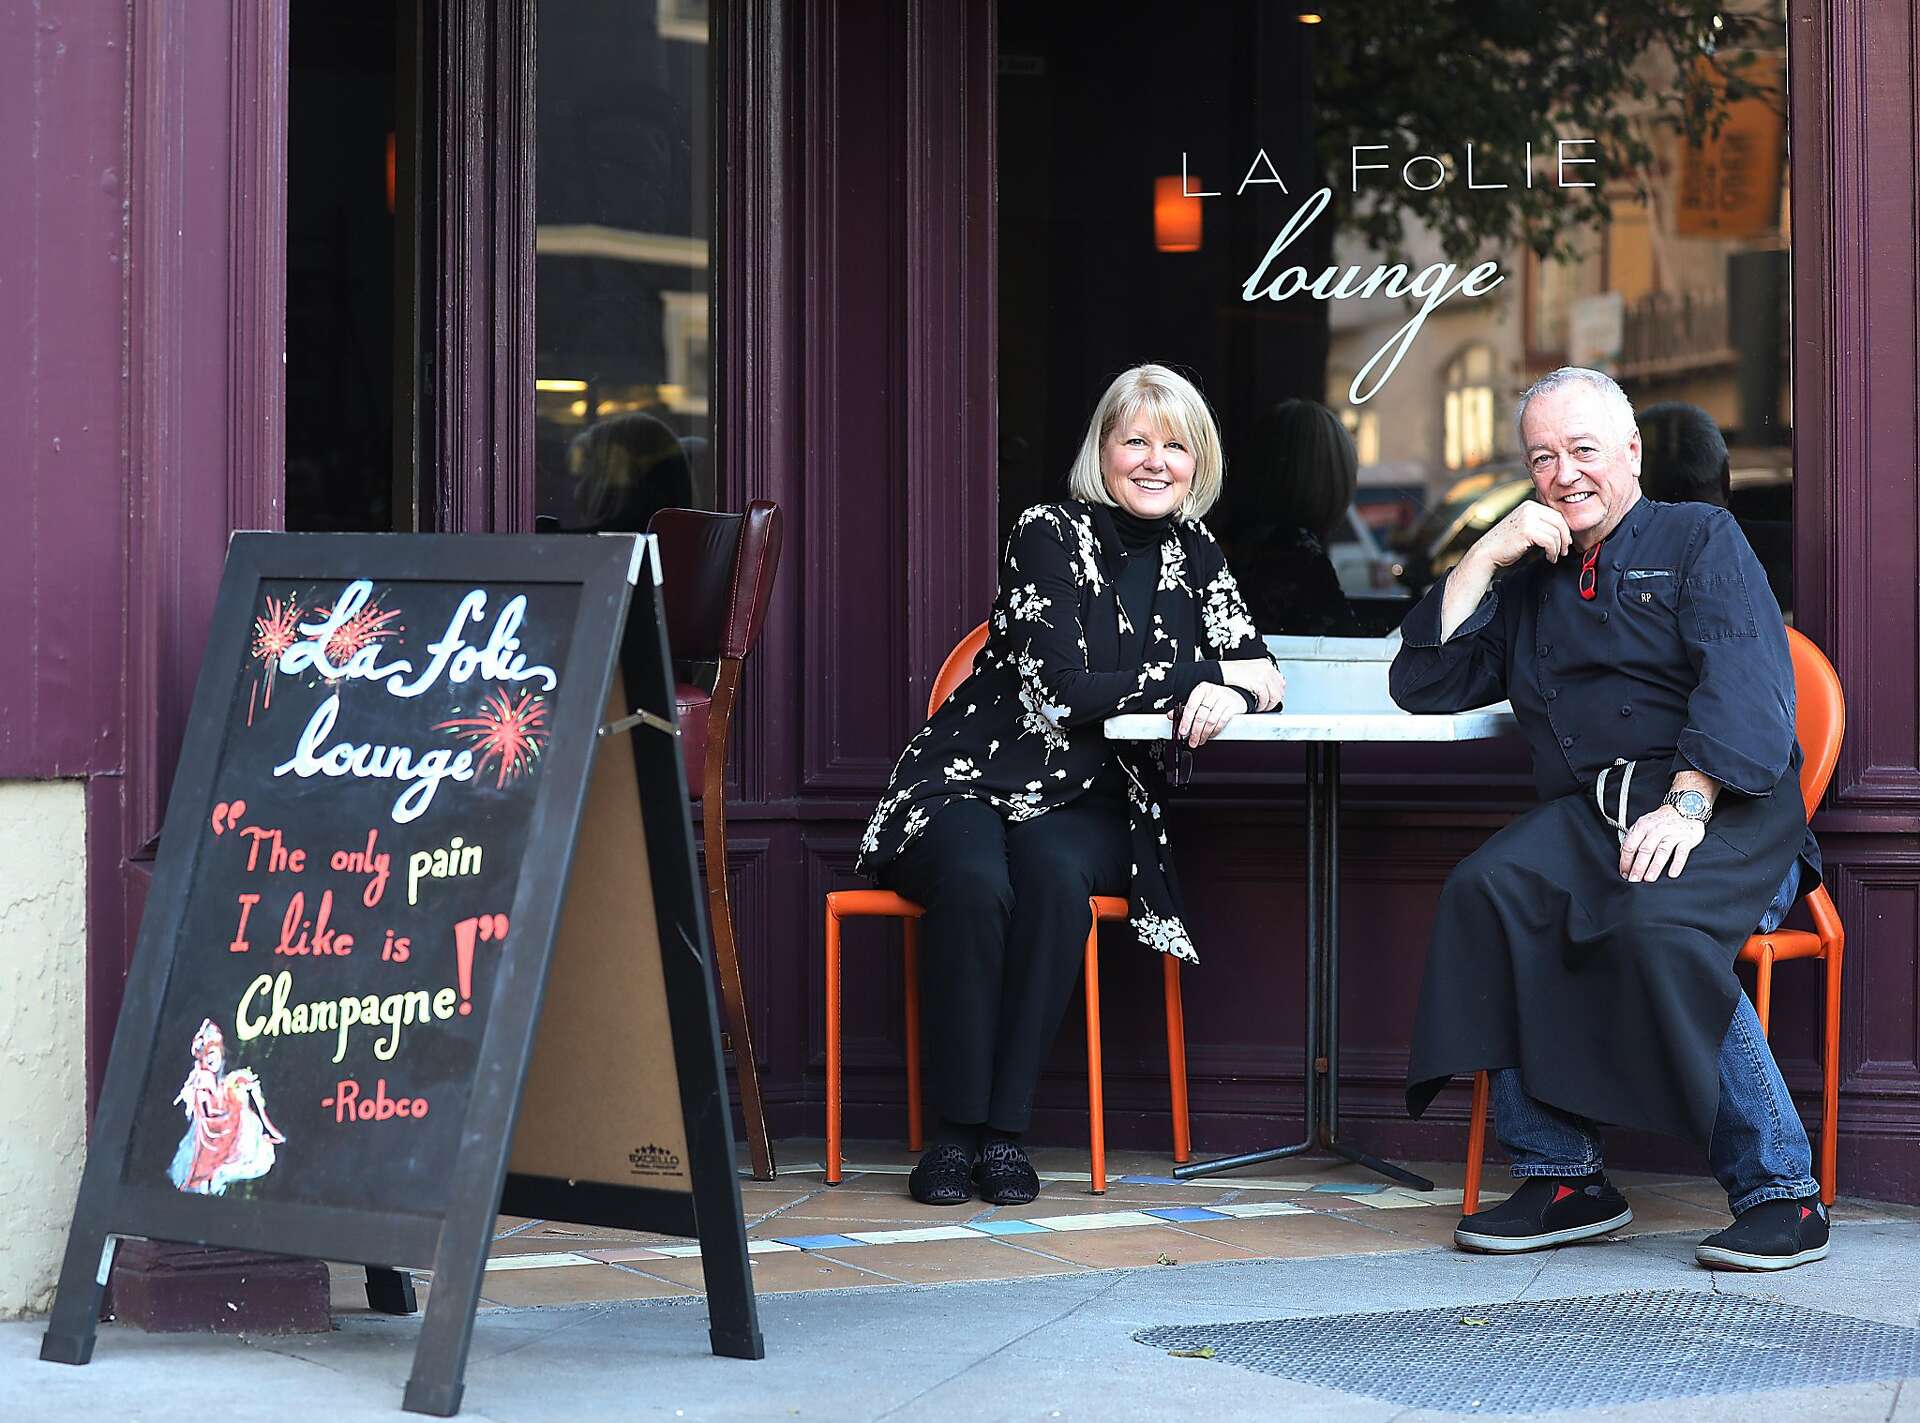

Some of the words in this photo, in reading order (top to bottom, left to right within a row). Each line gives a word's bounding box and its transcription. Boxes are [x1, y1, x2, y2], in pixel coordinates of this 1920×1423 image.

[1181, 148, 1289, 197] LA
[1241, 186, 1505, 405] lounge
[279, 579, 413, 680] La
[1640, 592, 1652, 603] RP
[273, 693, 475, 824] lounge
[330, 828, 391, 909] only
[407, 836, 484, 906] pain
[229, 893, 261, 954] I
[274, 889, 355, 957] like
[380, 929, 412, 964] is
